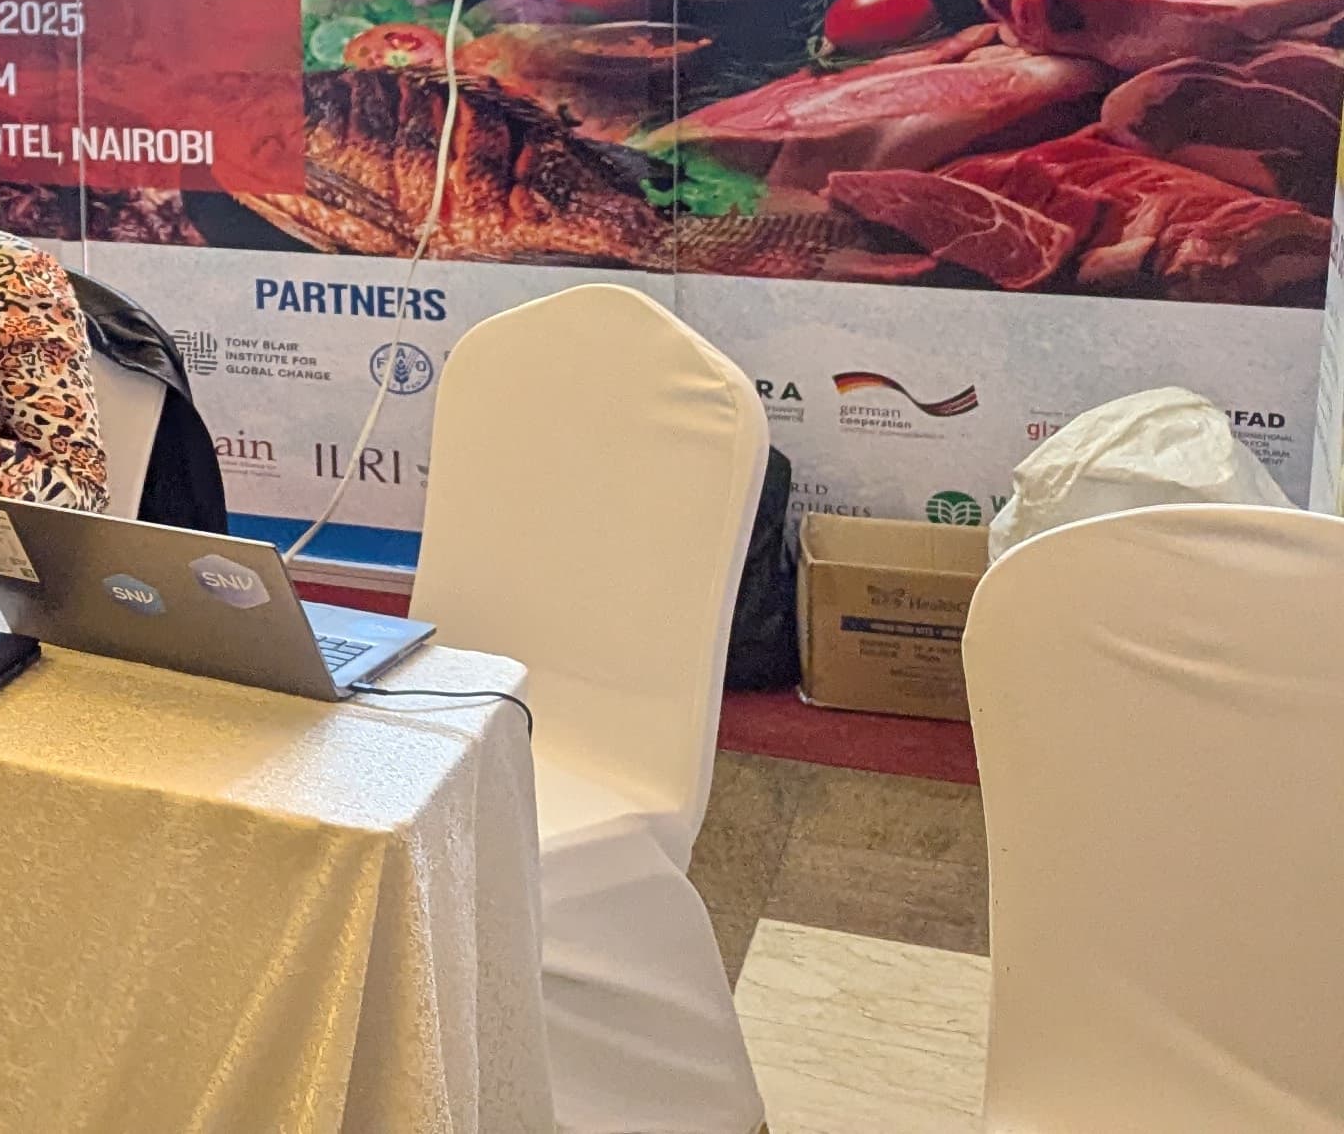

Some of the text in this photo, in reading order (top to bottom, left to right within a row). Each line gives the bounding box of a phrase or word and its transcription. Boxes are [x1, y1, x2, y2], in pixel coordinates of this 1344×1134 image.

[72, 127, 214, 165] NAIROBI
[255, 278, 447, 322] PARTNERS
[225, 337, 299, 352] TONY BLAIR
[225, 351, 317, 366] INSTITUTE FOR
[225, 364, 332, 381] GLOBAL CHANGE
[756, 379, 803, 401] RA
[840, 405, 901, 419] german
[840, 417, 913, 429] cooperation
[215, 429, 278, 462] ain
[315, 442, 401, 484] ILRI
[201, 570, 253, 591] SNV
[111, 586, 154, 604] SNV
